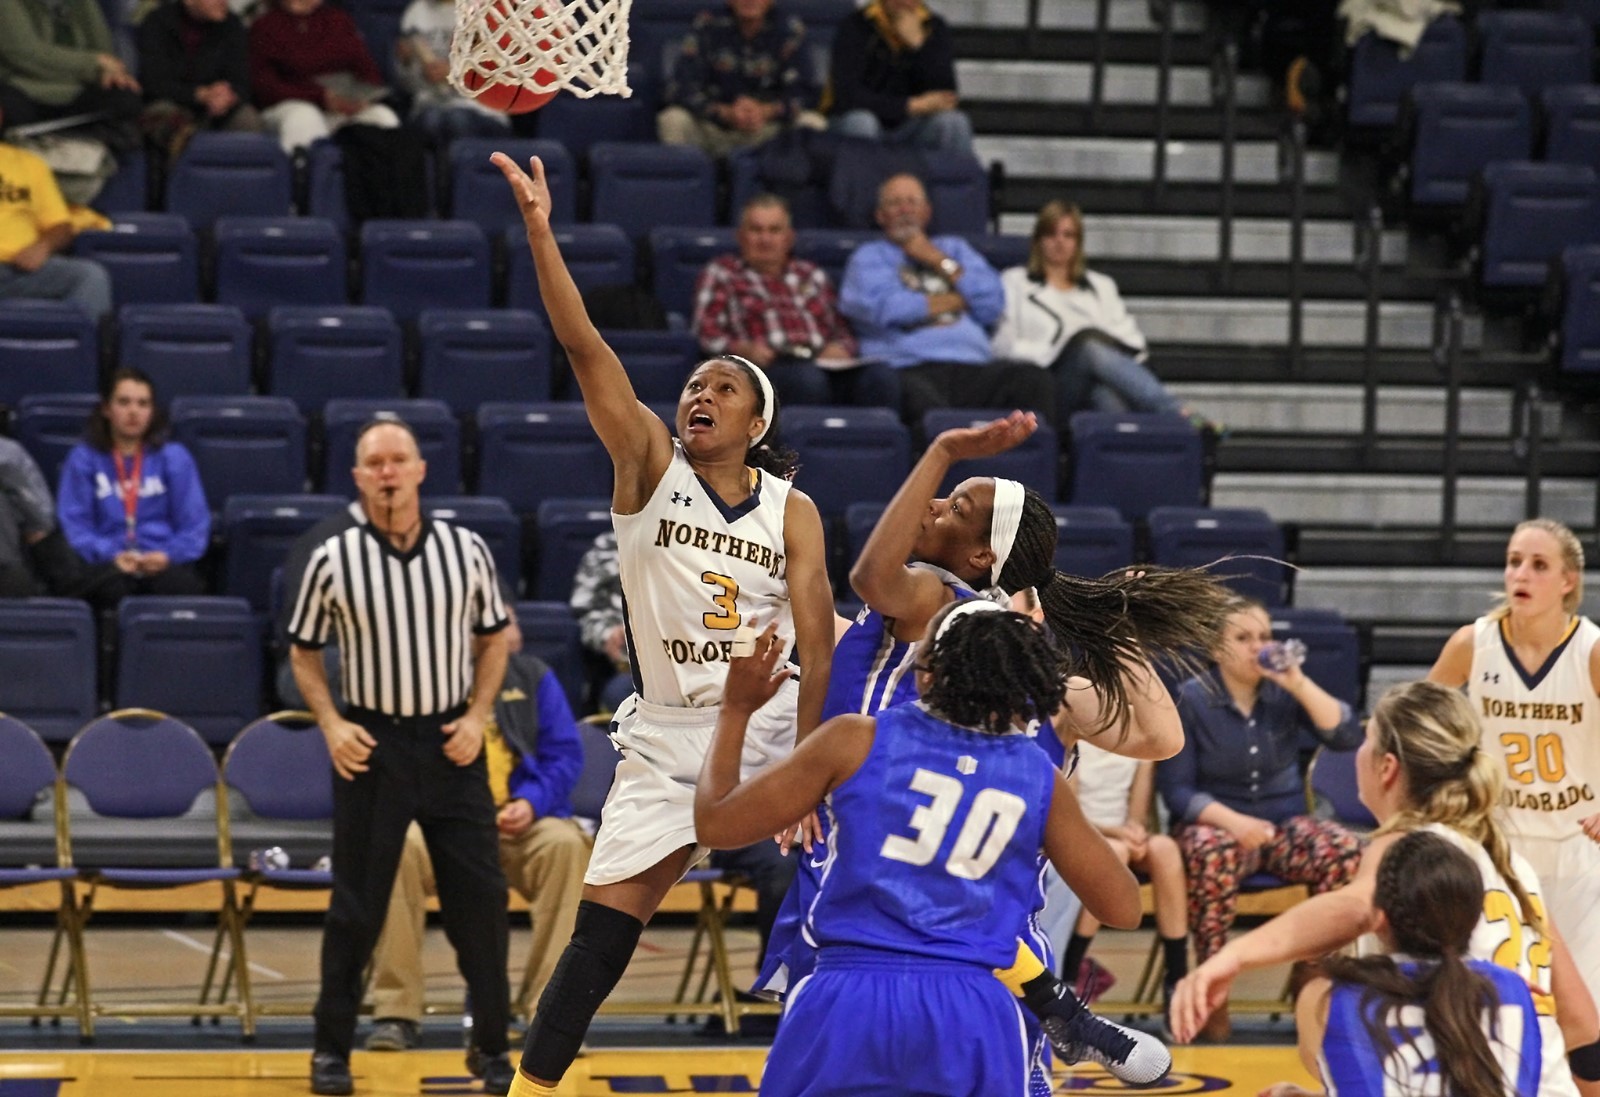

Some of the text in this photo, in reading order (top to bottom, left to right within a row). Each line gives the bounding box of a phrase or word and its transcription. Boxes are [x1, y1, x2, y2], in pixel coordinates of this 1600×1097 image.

[655, 518, 784, 579] NORTHERN
[701, 570, 741, 630] 3
[662, 638, 733, 664] COLOR
[1481, 697, 1584, 725] NORTHERN
[1500, 732, 1567, 785] 20
[879, 767, 1027, 881] 30
[1500, 783, 1595, 812] OLORADO
